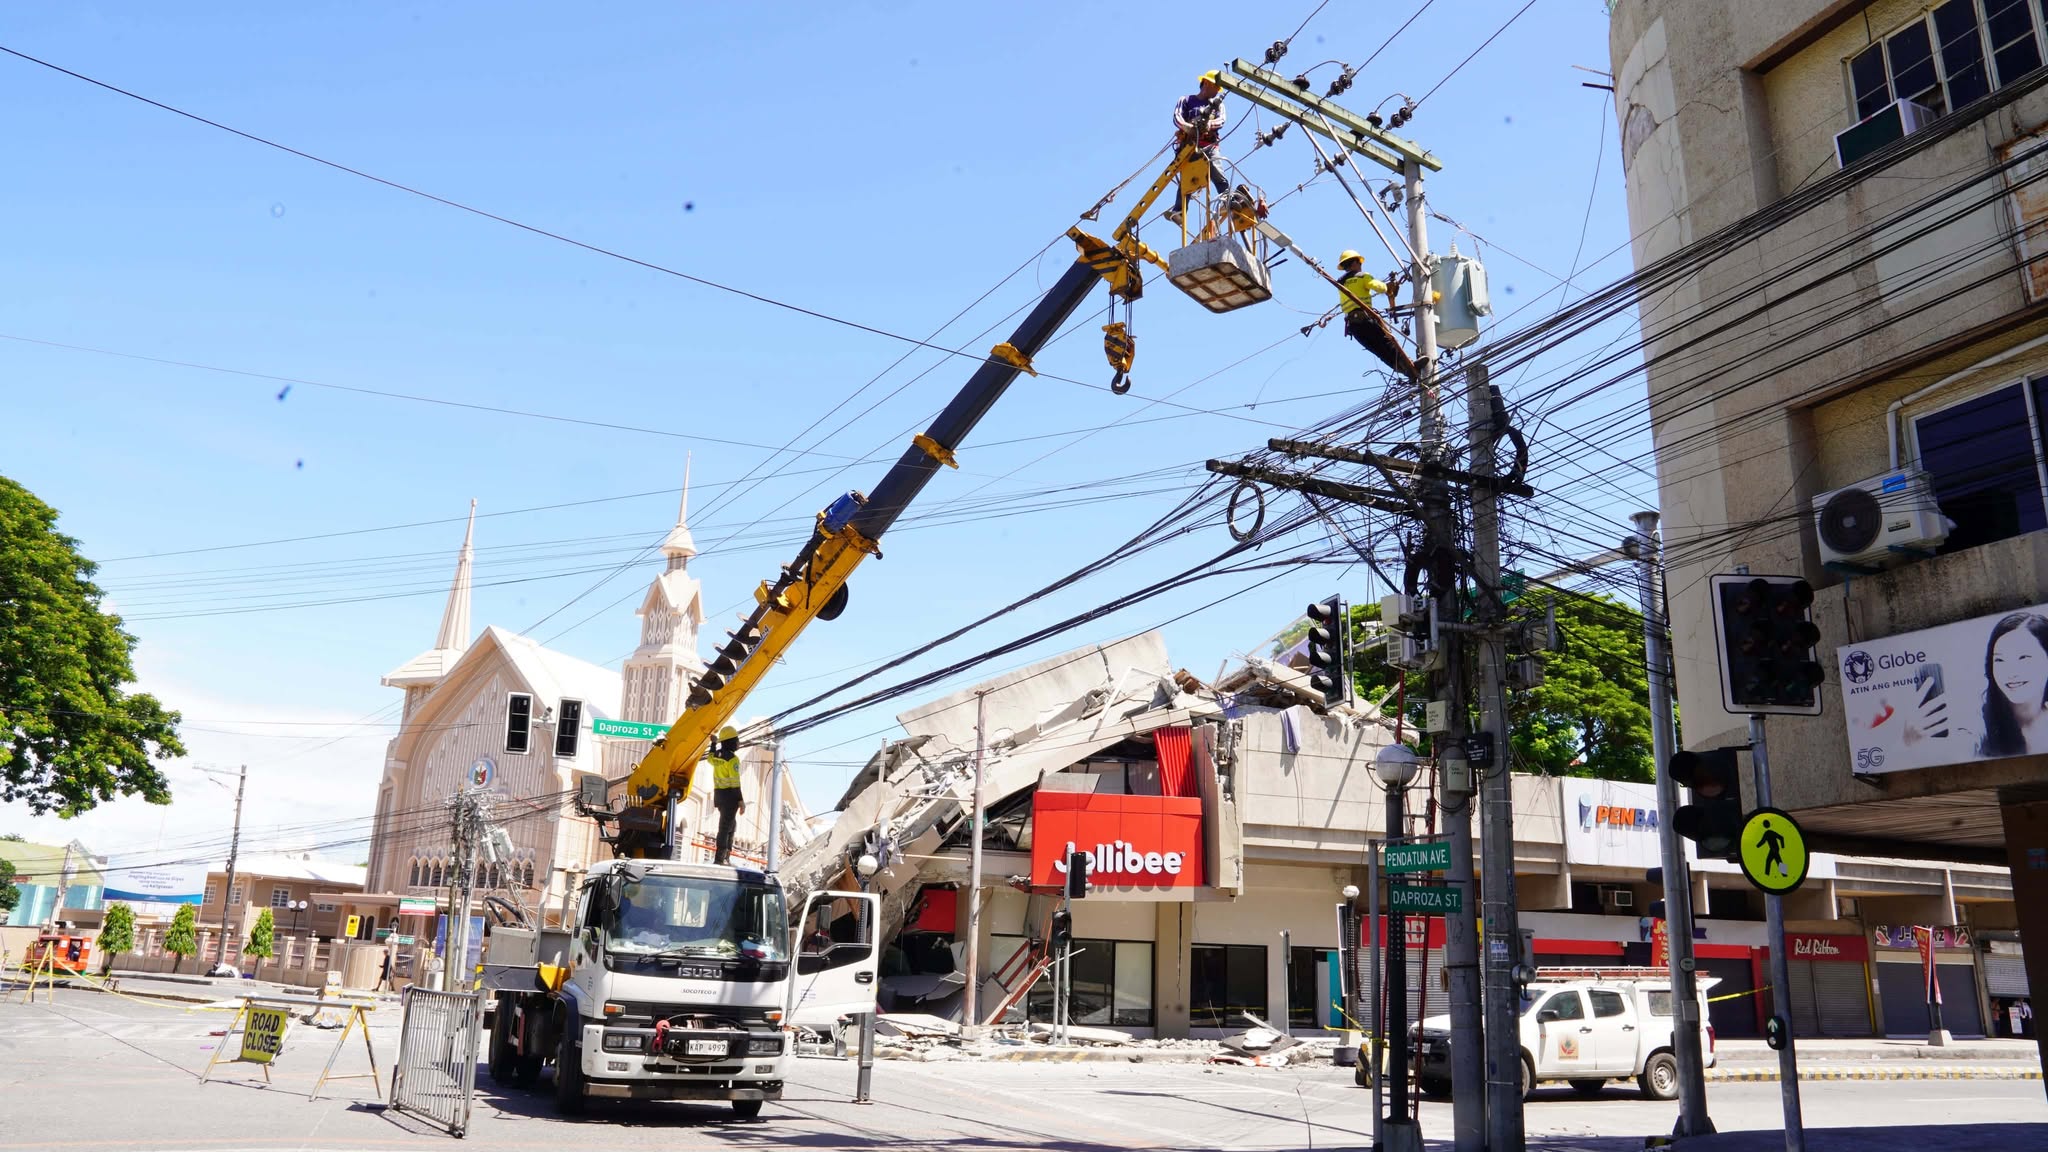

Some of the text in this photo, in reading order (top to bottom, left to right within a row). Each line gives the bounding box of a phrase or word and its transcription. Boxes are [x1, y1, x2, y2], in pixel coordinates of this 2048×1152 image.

[1878, 650, 1927, 670] Globe
[1850, 686, 1870, 695] ATIN
[1872, 682, 1890, 691] ANG
[599, 722, 655, 736] Daproza St.
[1857, 746, 1885, 769] 5G
[1596, 805, 1659, 828] PENBA
[1386, 848, 1449, 867] PENDATUN AVE.
[1392, 890, 1461, 907] DAPROZA ST.
[1794, 938, 1840, 956] Red Ribbon
[677, 967, 722, 979] ISUZU
[251, 1012, 280, 1033] ROAD
